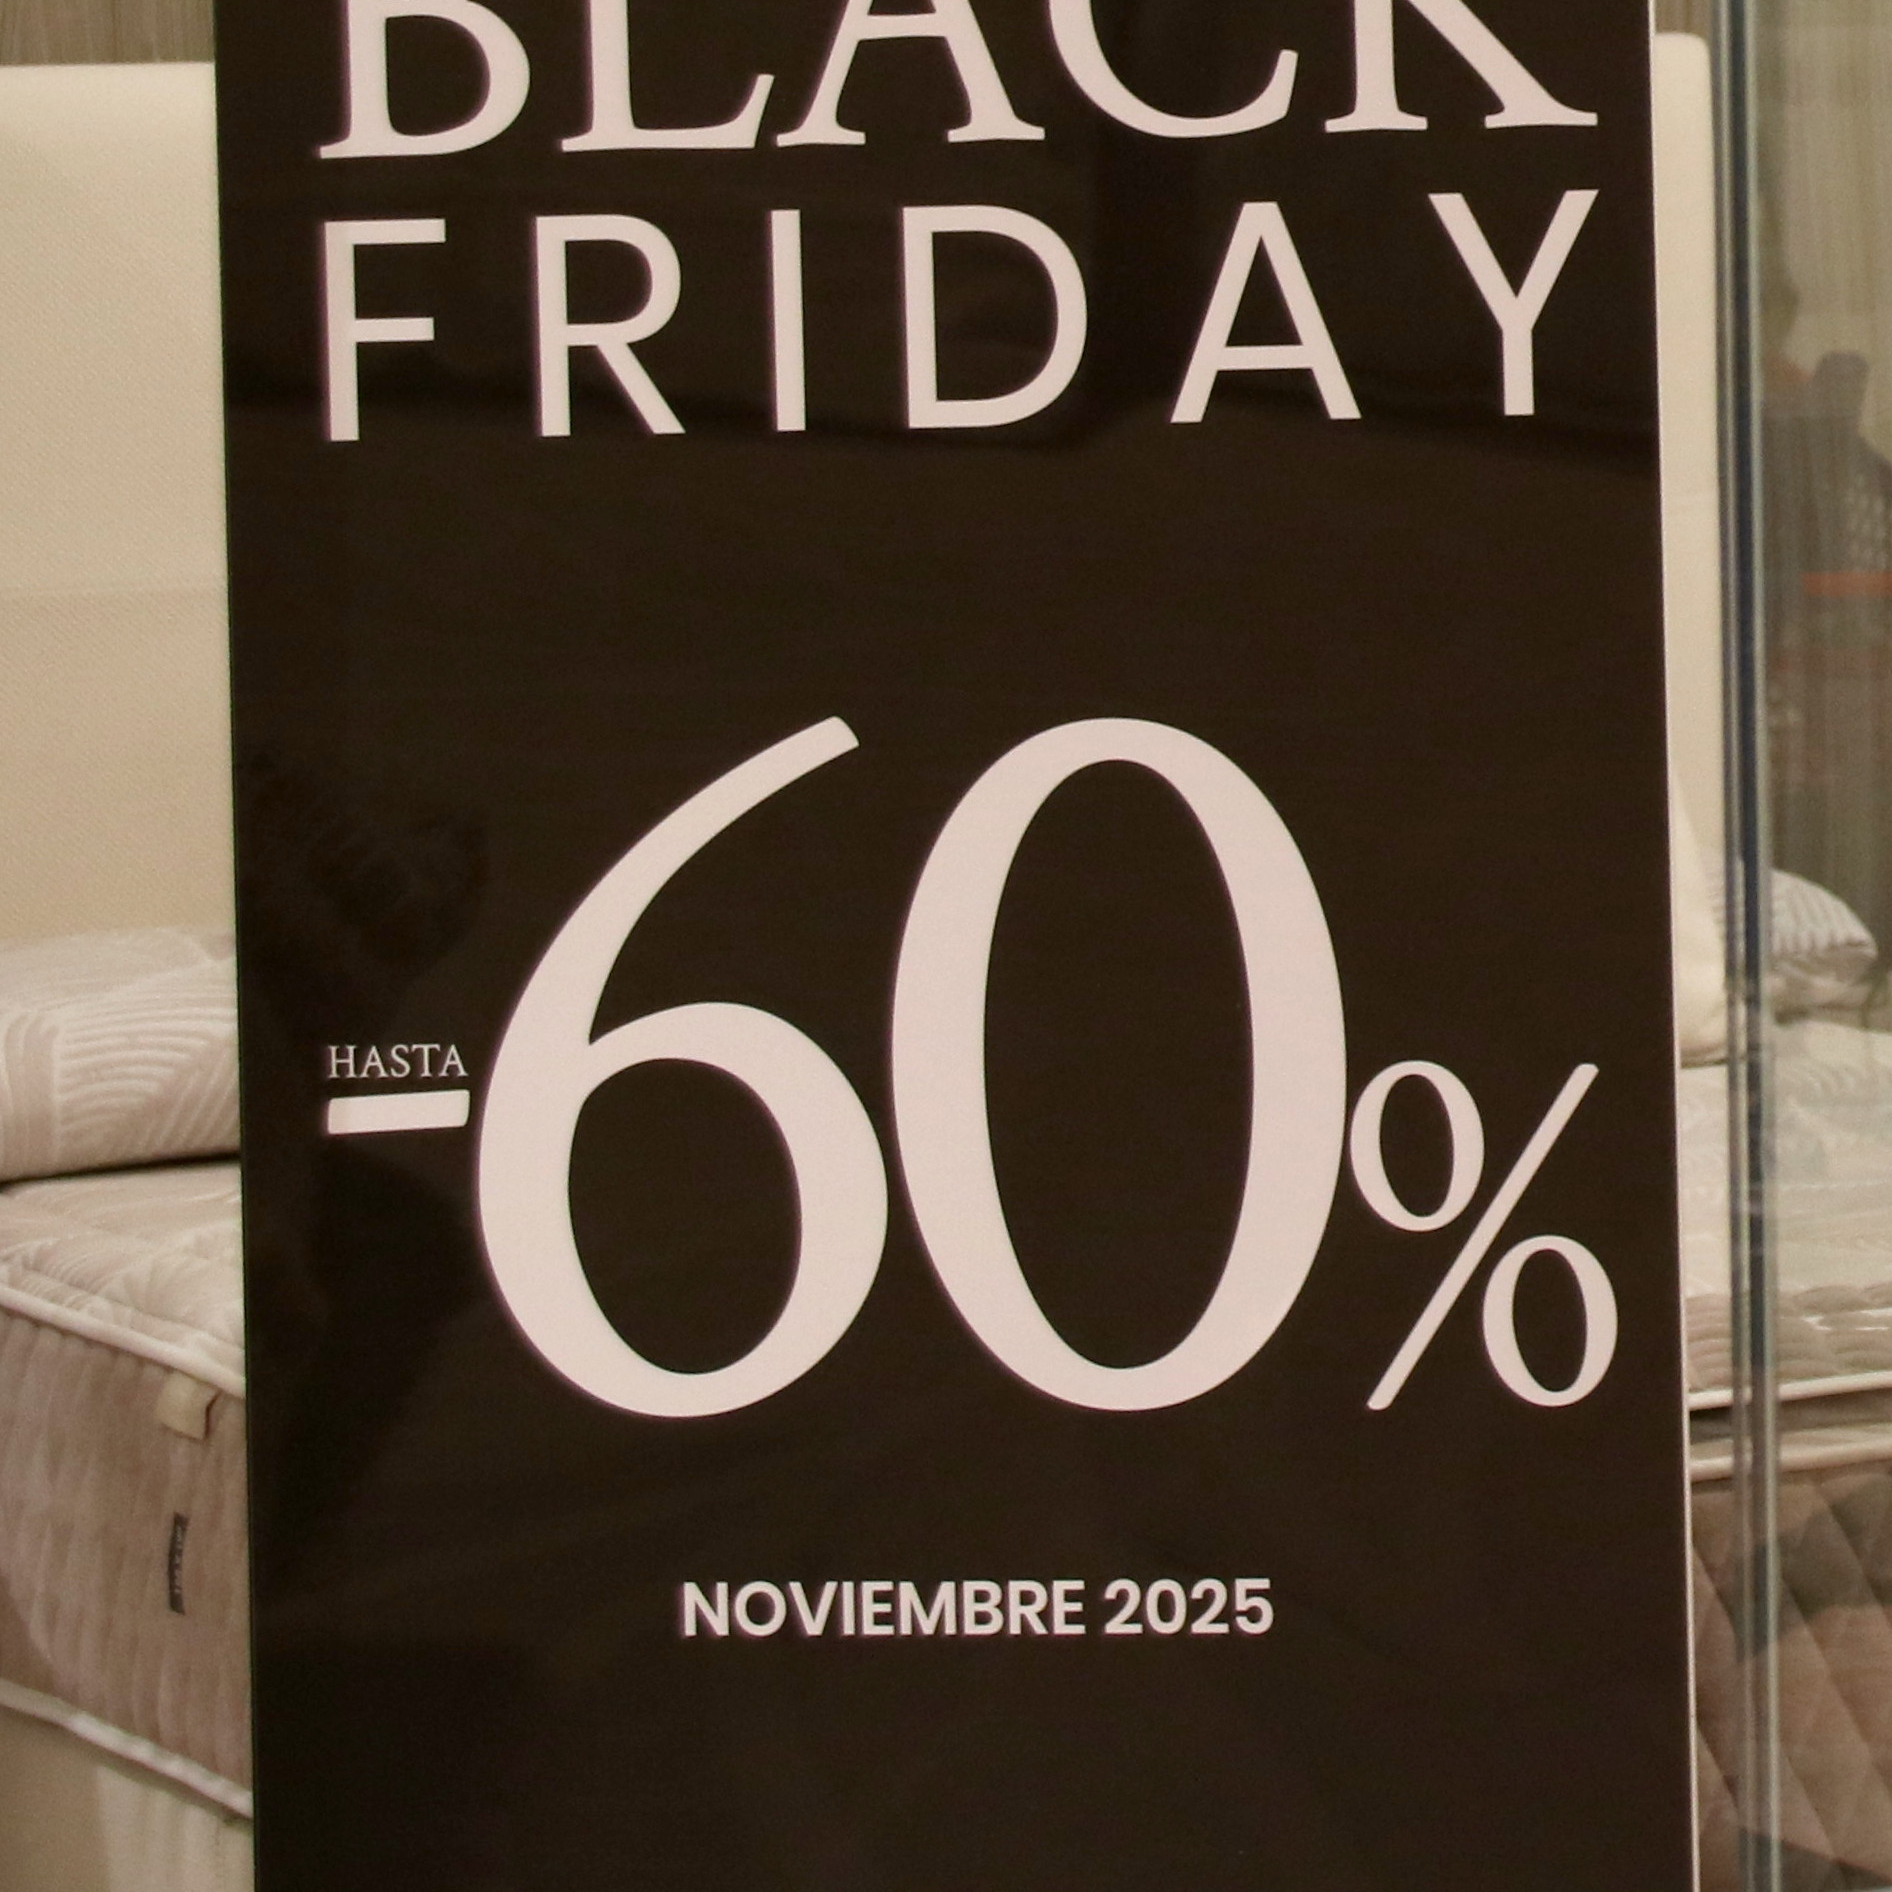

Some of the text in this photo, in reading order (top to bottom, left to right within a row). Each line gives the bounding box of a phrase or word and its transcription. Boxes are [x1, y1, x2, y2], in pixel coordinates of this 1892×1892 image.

[323, 188, 1598, 442] FRIDAY
[326, 1044, 469, 1081] HASTA
[681, 1578, 1275, 1638] NOVIEMBRE 2025
